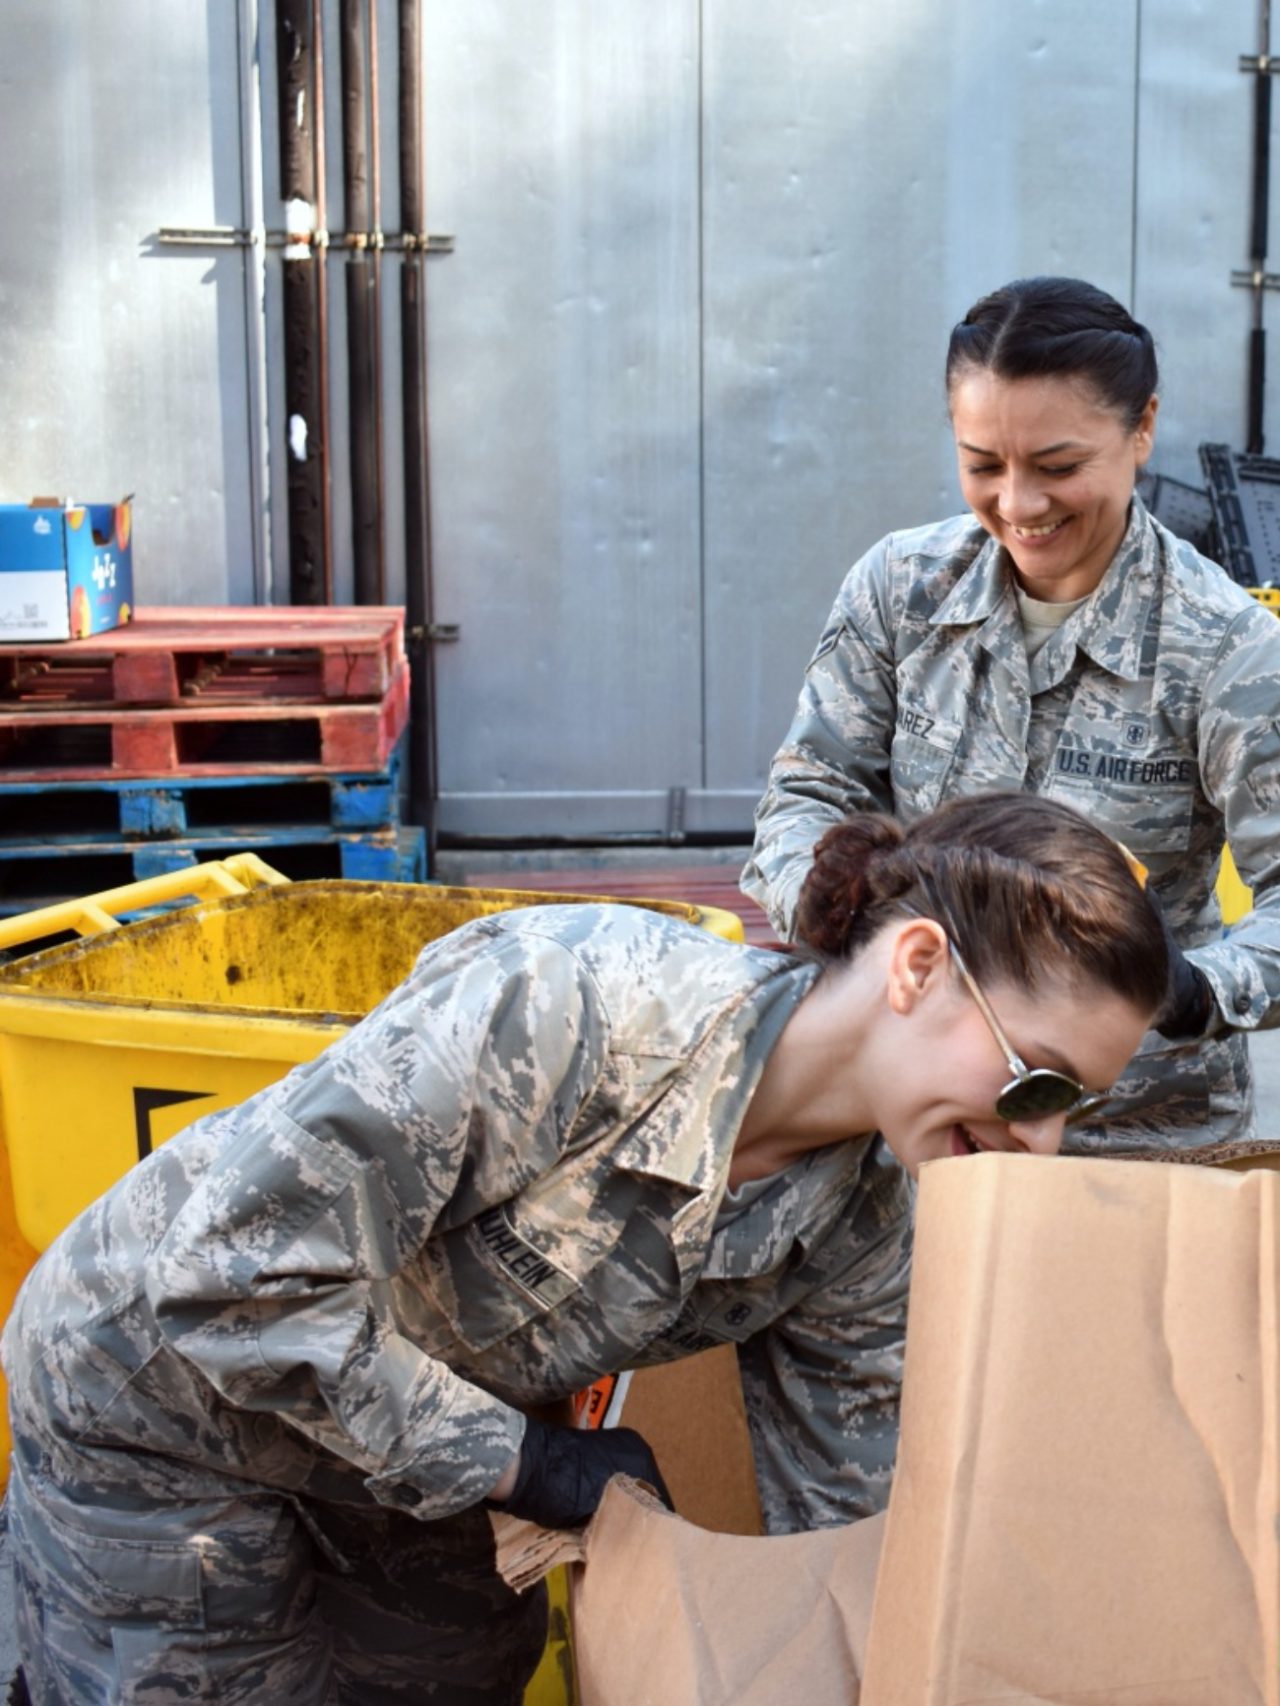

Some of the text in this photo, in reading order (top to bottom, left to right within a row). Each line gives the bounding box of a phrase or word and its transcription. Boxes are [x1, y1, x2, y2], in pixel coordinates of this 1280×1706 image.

[1058, 748, 1193, 784] U.S. AIR FORCE
